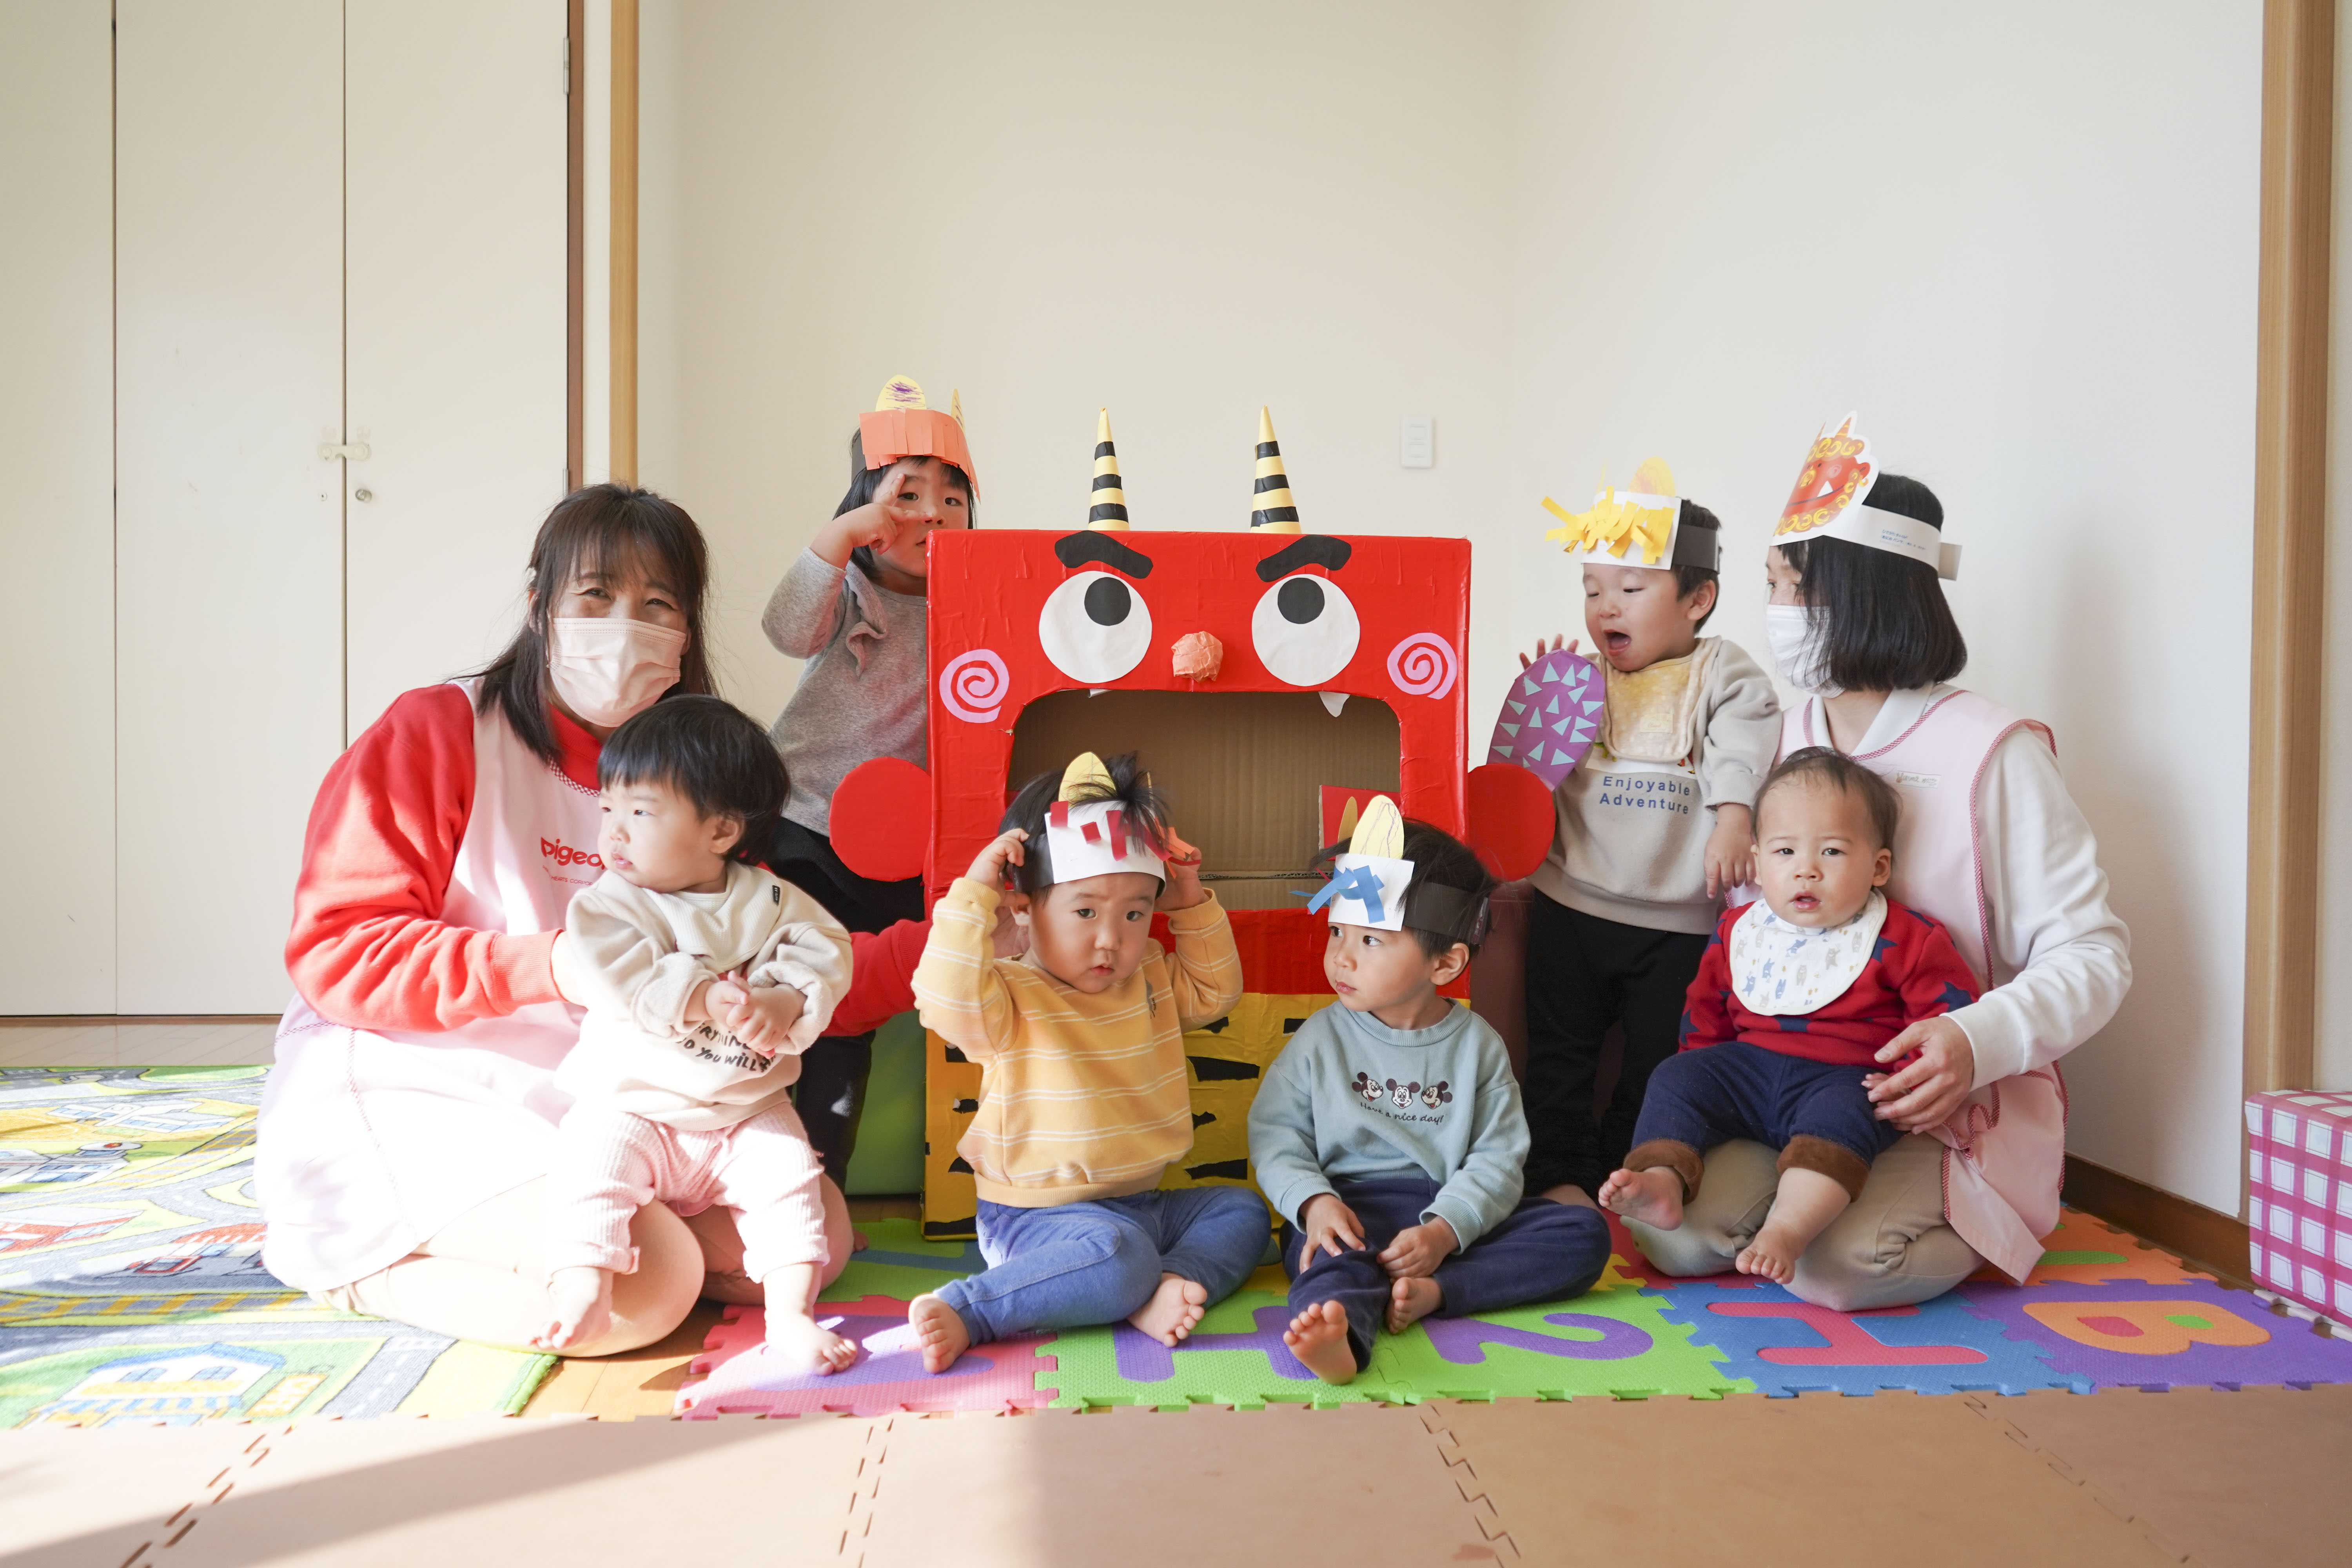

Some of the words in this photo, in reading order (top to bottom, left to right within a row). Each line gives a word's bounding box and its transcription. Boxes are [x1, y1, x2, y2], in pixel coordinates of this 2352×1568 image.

[1603, 776, 1690, 796] Enjoyable
[1599, 793, 1689, 814] Adventure
[1360, 1102, 1383, 1114] Have
[1394, 1112, 1417, 1122] nice
[1420, 1114, 1444, 1125] day!
